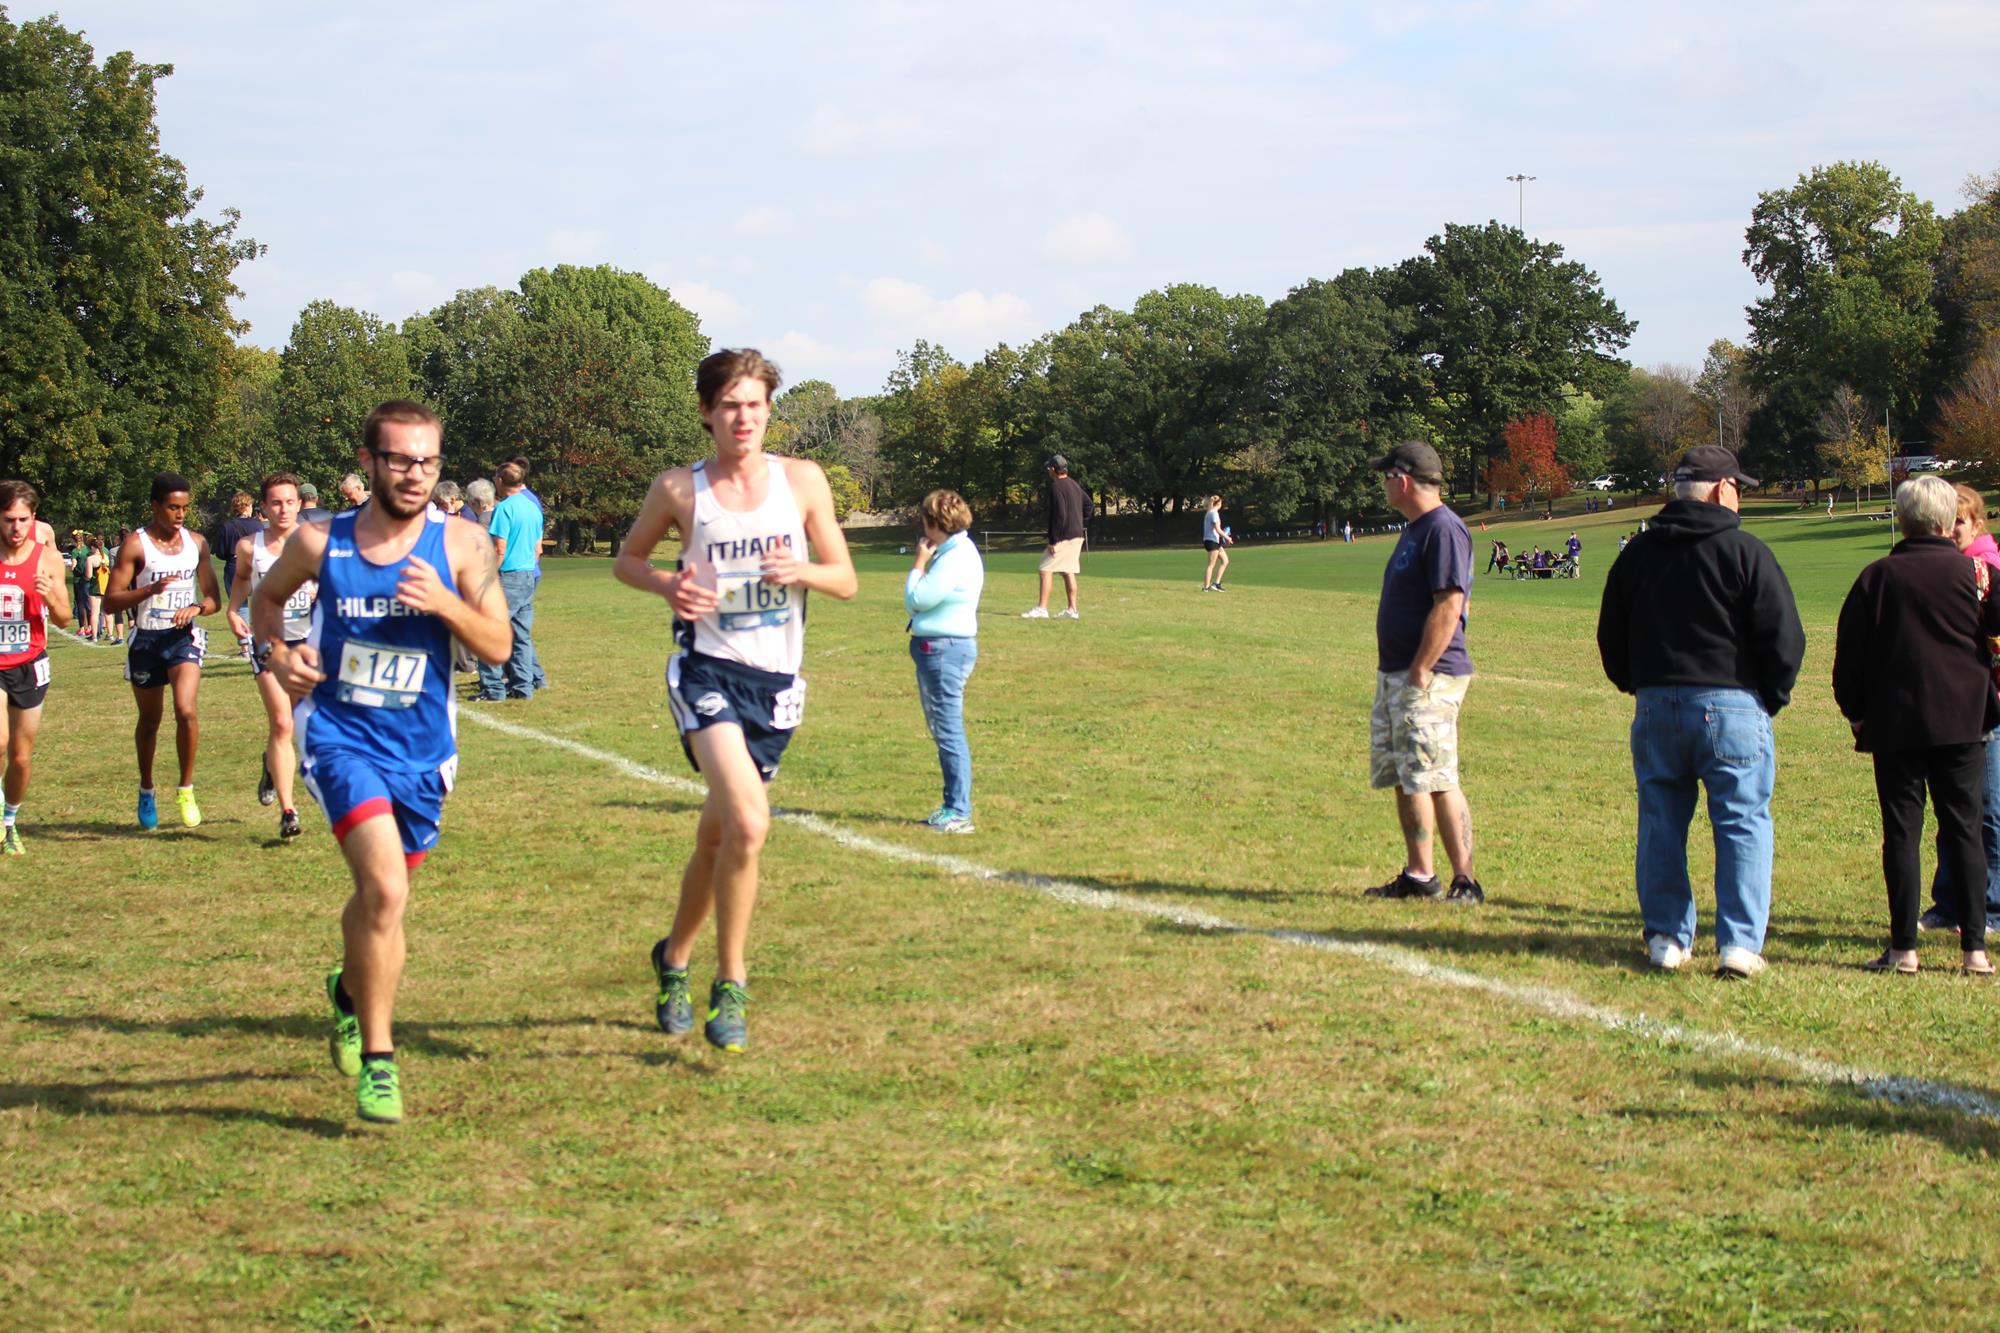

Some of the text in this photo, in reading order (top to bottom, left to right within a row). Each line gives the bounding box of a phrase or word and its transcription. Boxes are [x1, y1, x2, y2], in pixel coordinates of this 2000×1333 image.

[167, 591, 191, 609] 156
[743, 580, 788, 611] 163
[336, 597, 429, 618] HILBER
[0, 625, 28, 642] 136
[369, 652, 420, 689] 147
